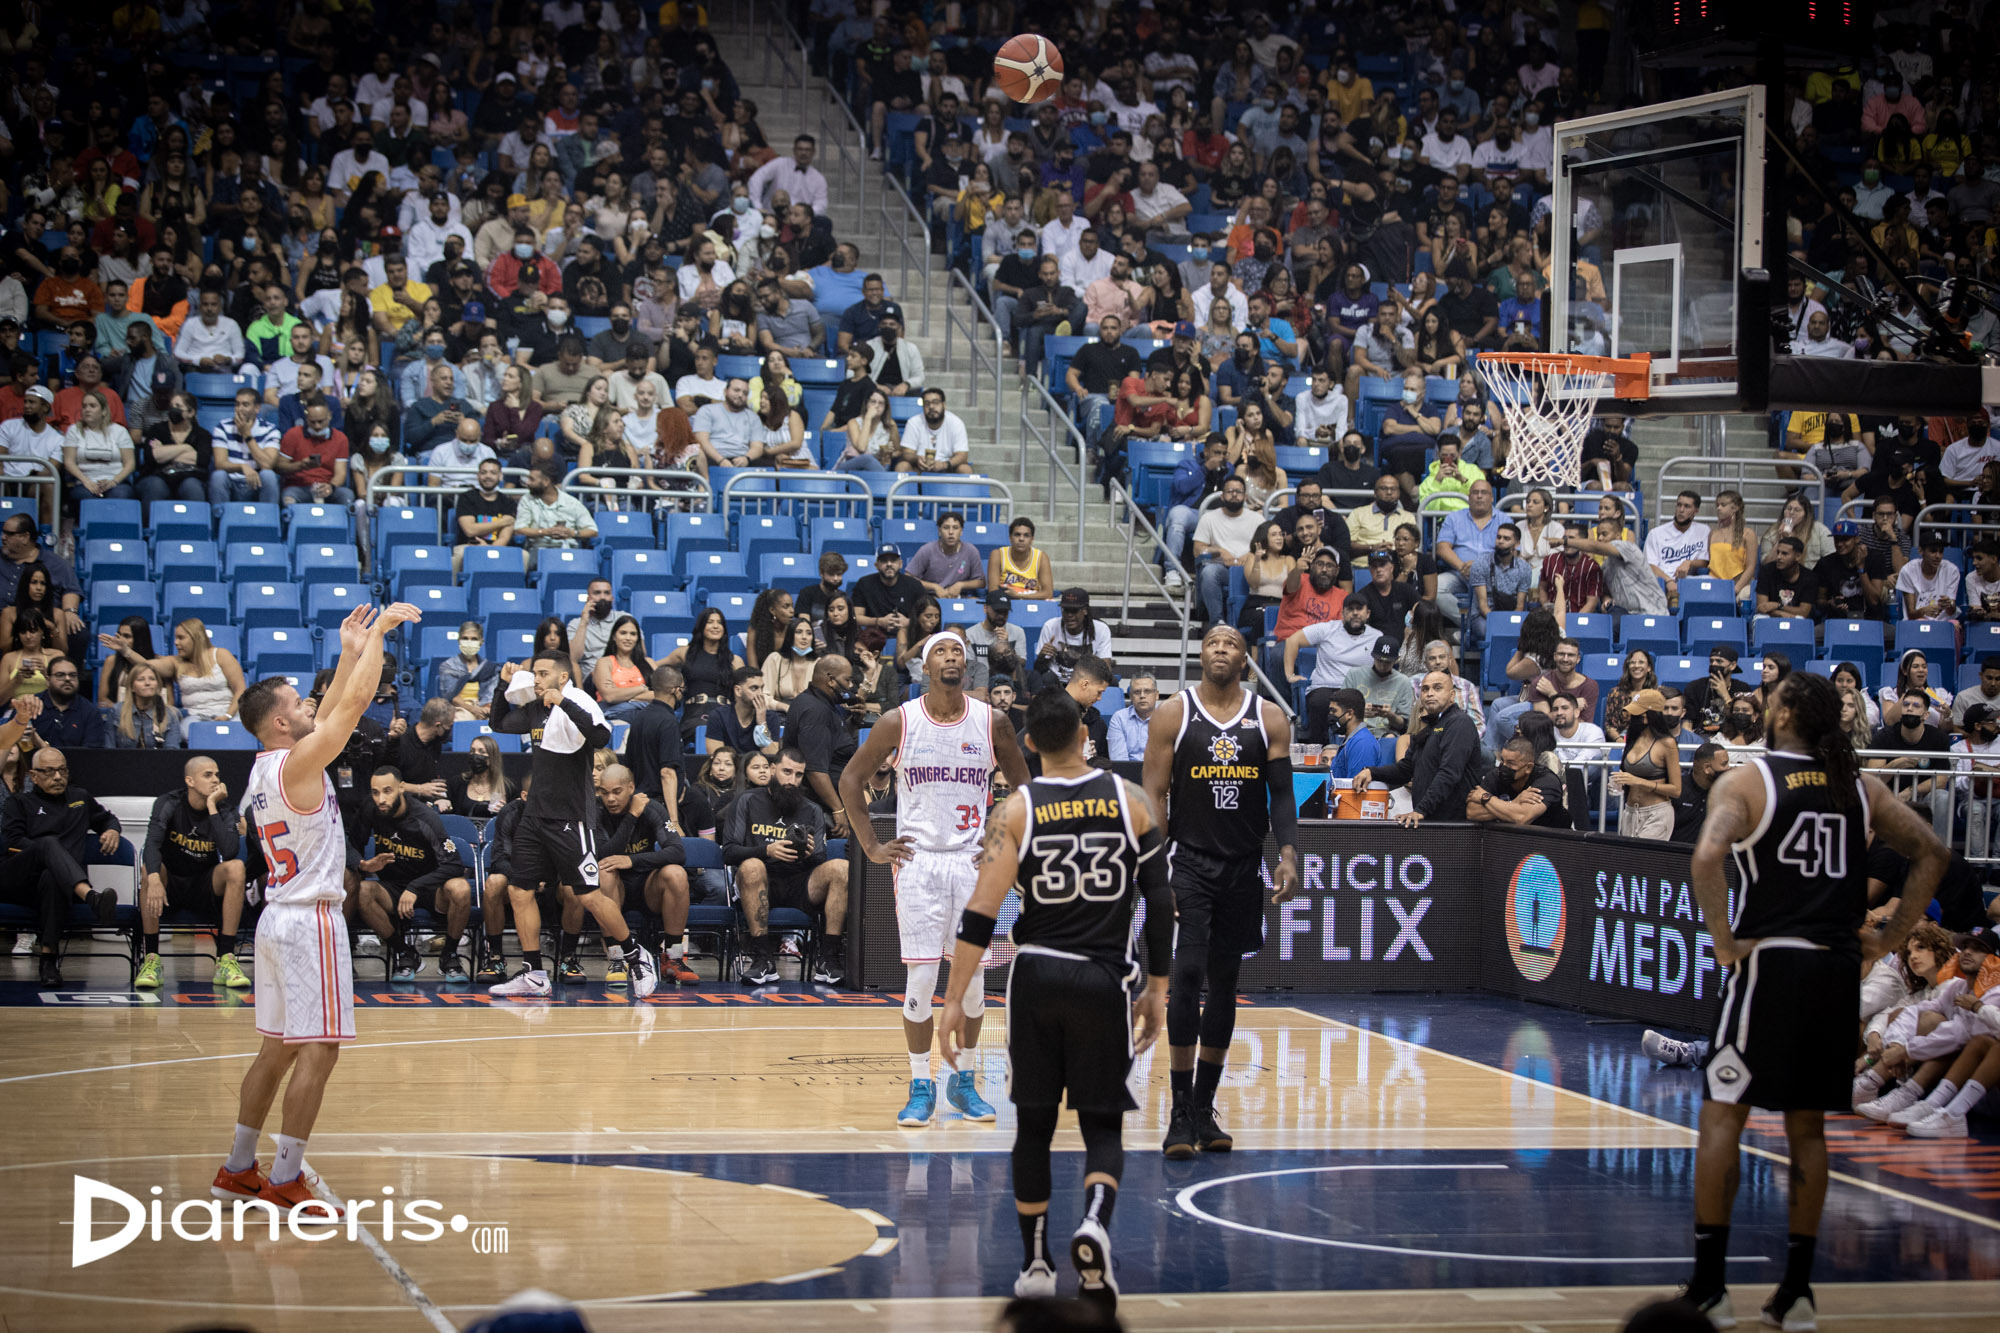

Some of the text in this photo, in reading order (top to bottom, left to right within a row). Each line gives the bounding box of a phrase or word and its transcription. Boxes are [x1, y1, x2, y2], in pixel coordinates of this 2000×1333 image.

[1661, 541, 1704, 561] Dodgers
[1191, 765, 1259, 779] CAPITANES
[1212, 785, 1239, 810] 12
[956, 804, 981, 830] 33
[1034, 798, 1119, 825] HUERTAS
[1777, 811, 1847, 878] 41
[1031, 832, 1127, 905] 33
[1595, 870, 1647, 914] SAN
[1262, 896, 1434, 960] FLIX
